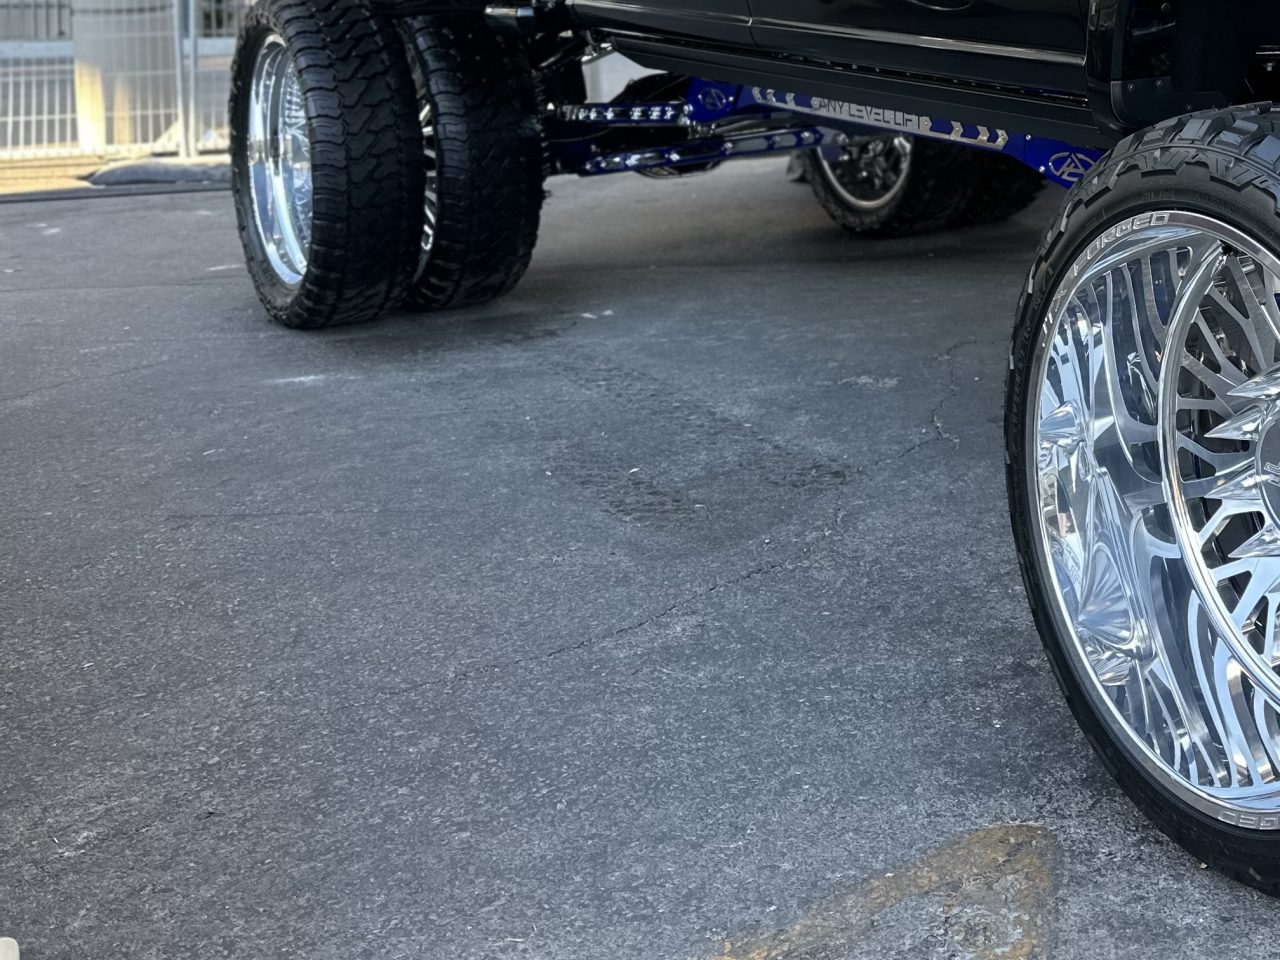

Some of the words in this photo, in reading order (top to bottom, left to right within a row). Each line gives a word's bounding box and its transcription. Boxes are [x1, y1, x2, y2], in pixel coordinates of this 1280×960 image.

[818, 98, 845, 115] ANY
[848, 103, 890, 124] LEVEL
[894, 112, 923, 129] LIFT
